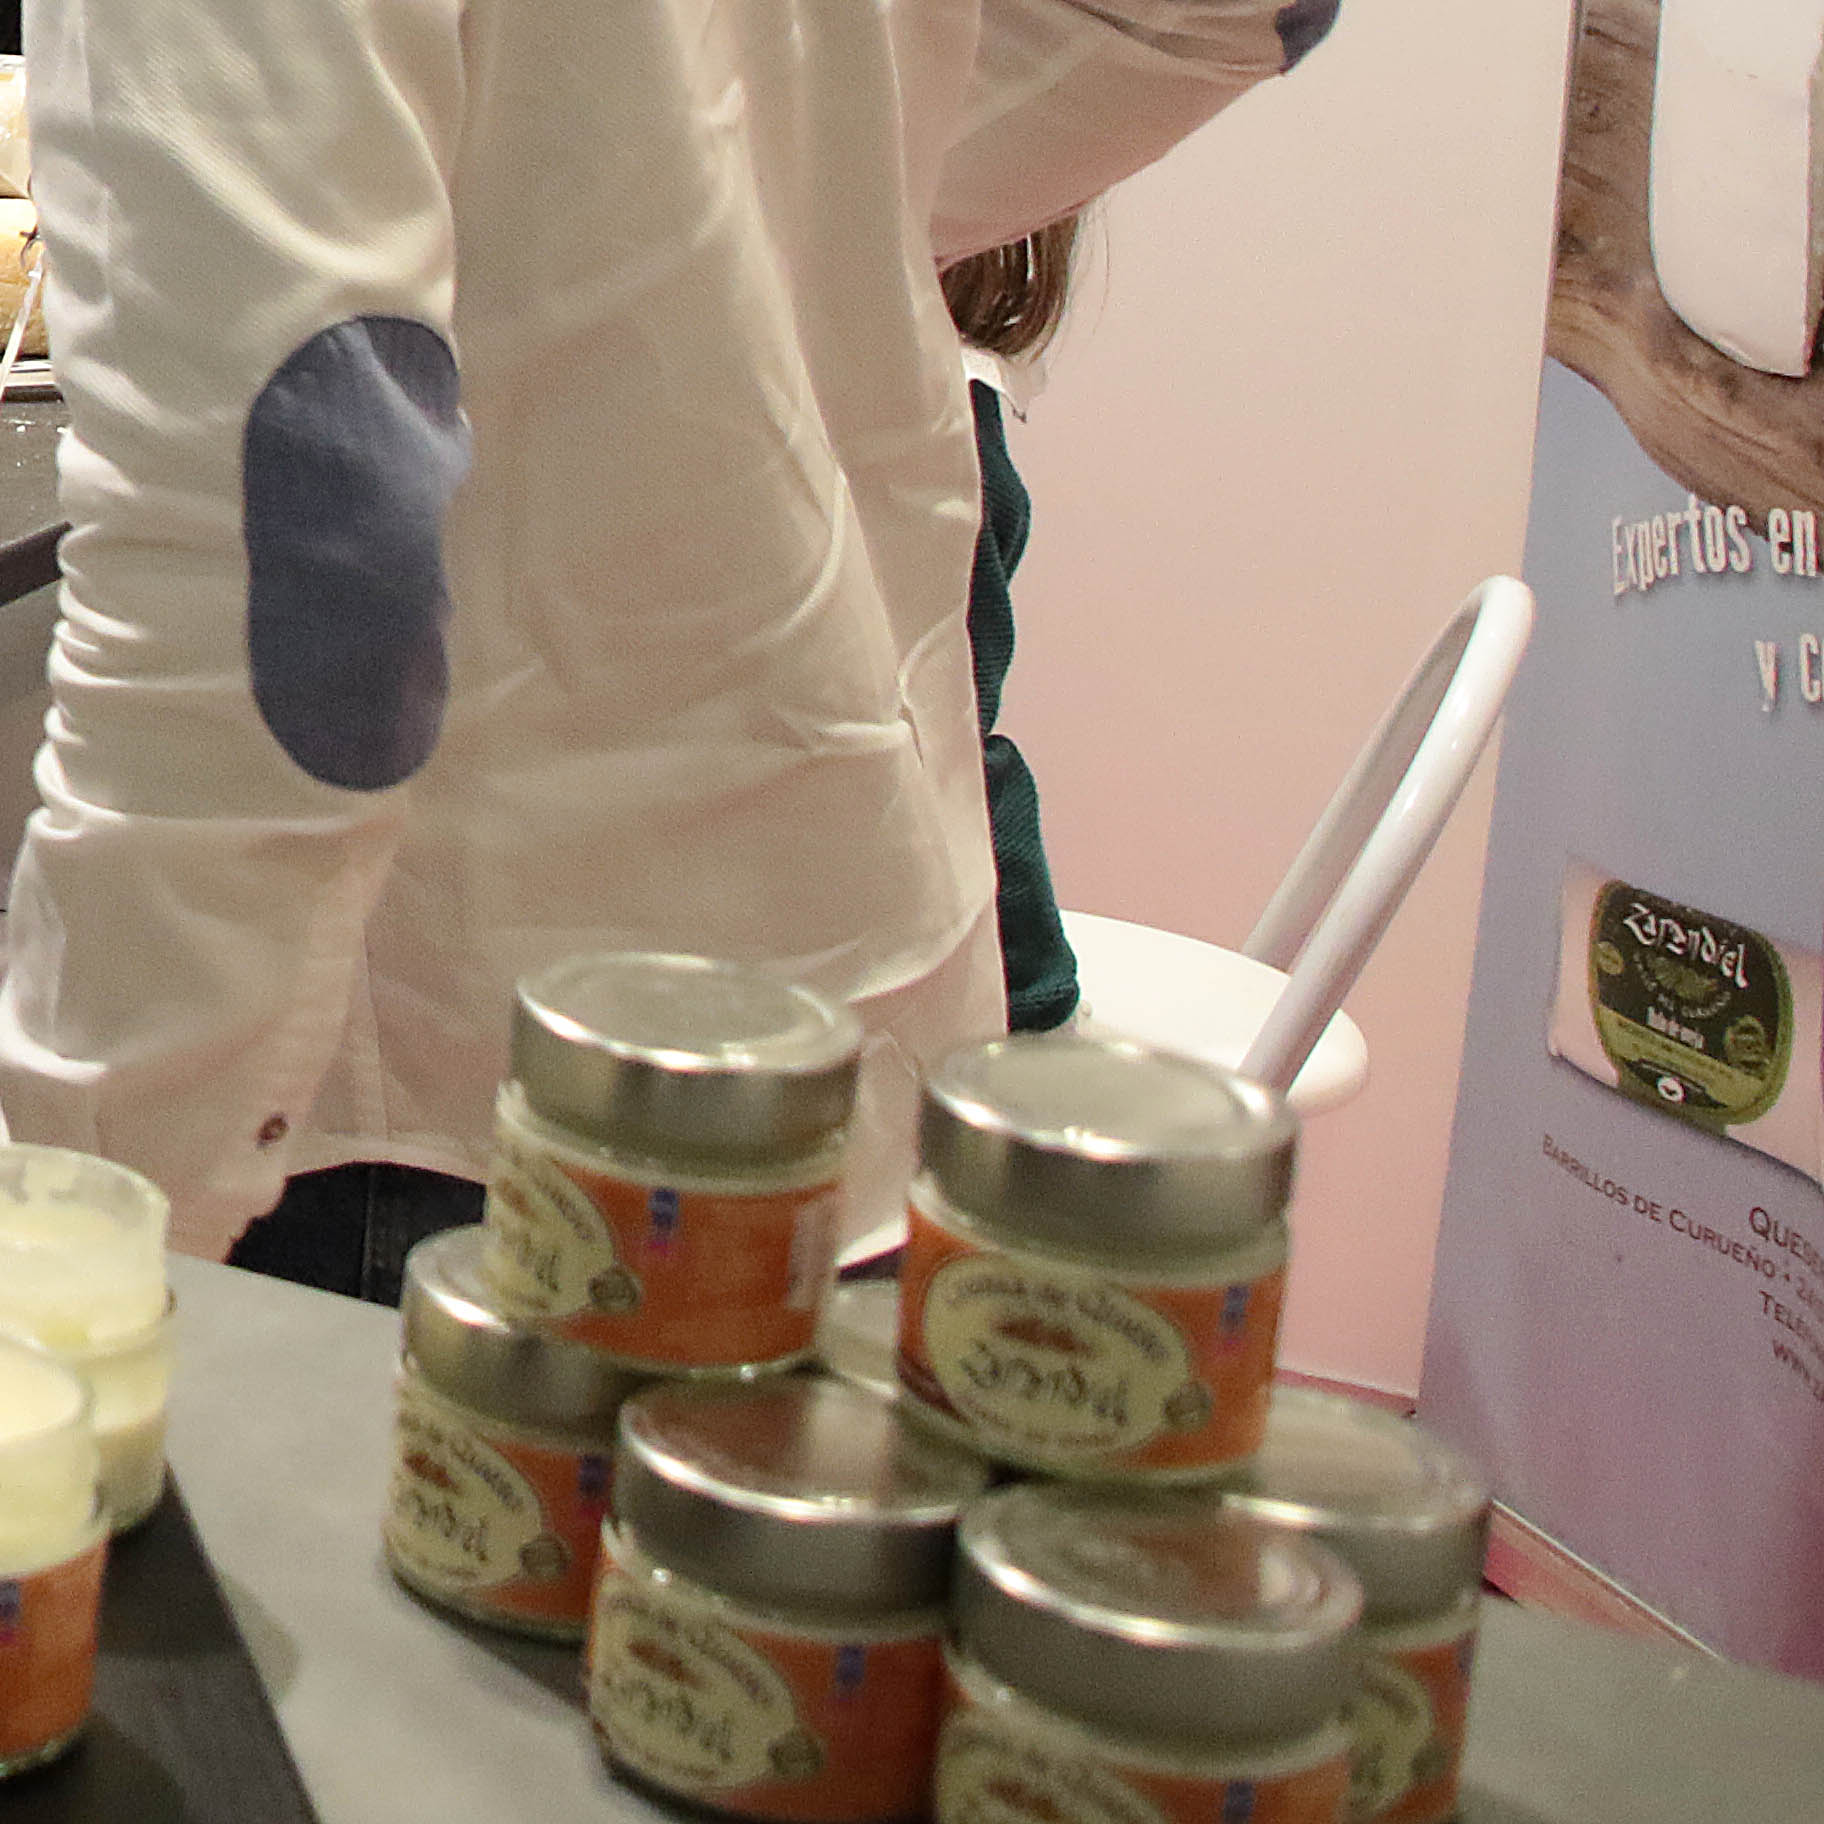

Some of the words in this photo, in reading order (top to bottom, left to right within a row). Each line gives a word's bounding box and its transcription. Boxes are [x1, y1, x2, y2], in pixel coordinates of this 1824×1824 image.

[1612, 493, 1753, 595] Expertos
[1768, 508, 1817, 577] en
[1754, 640, 1779, 712] y
[1622, 903, 1751, 989] Zarandiel
[1633, 1194, 1663, 1223] DE
[1668, 1208, 1776, 1279] CURUEÑO
